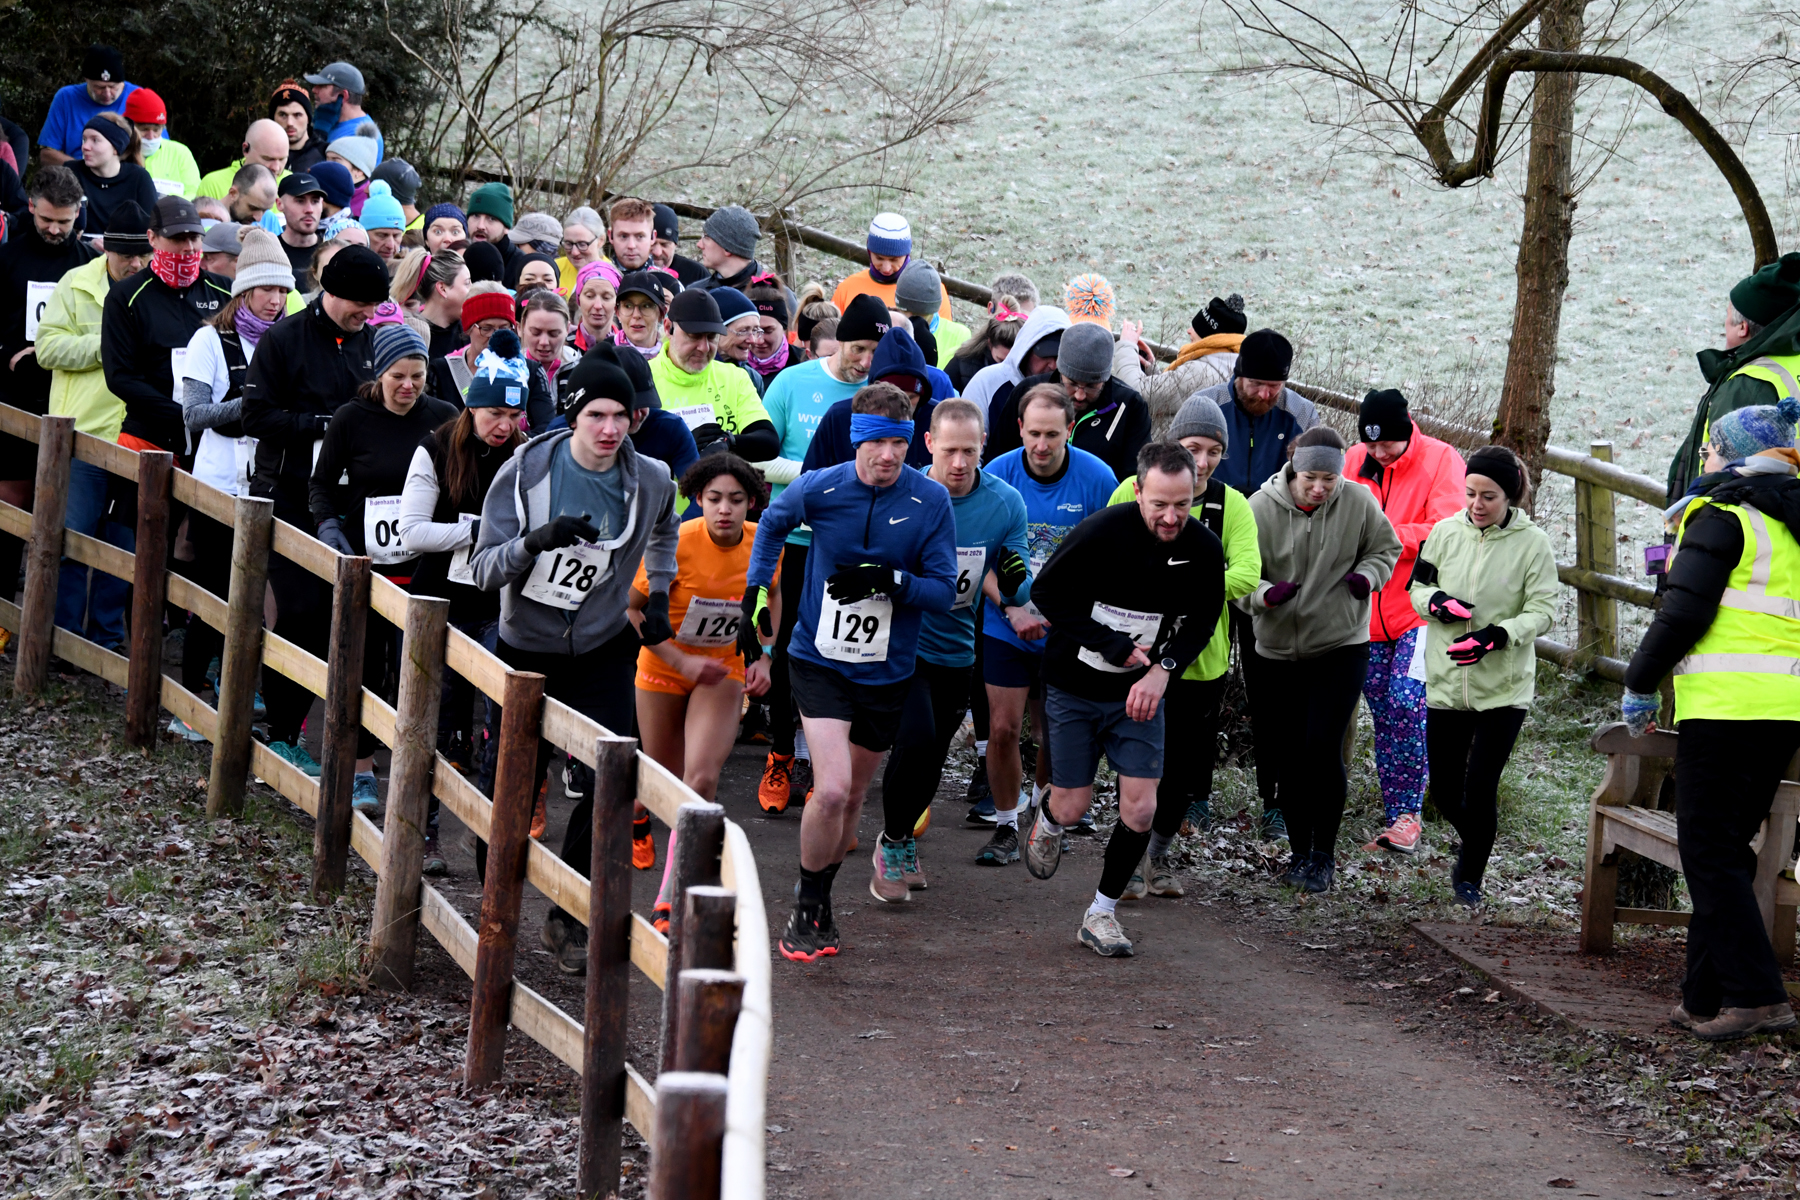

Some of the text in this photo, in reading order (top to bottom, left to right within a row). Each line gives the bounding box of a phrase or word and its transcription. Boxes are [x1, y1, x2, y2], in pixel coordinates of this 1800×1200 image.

[375, 519, 402, 548] 09
[969, 549, 983, 557] 2026
[547, 552, 598, 593] 128
[696, 616, 740, 637] 126
[832, 610, 880, 644] 129
[1127, 612, 1145, 621] Bound
